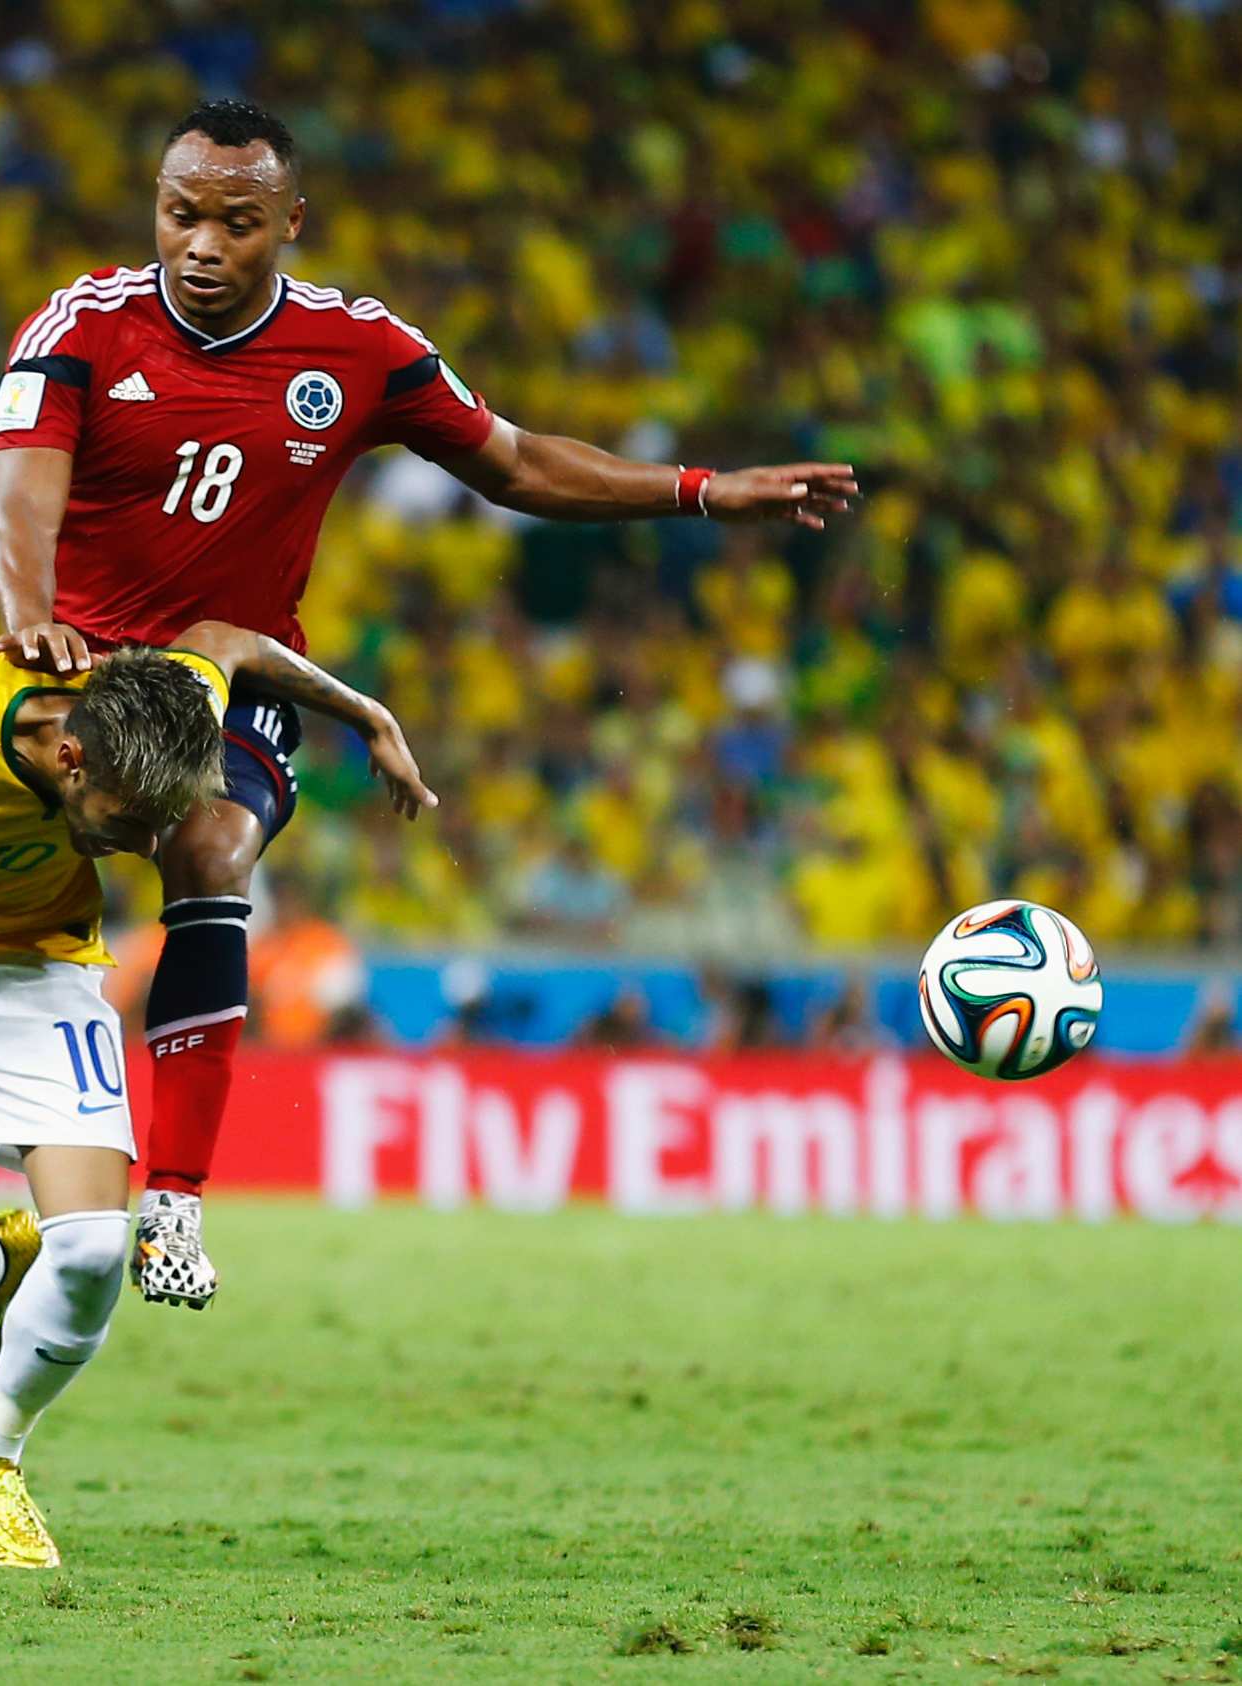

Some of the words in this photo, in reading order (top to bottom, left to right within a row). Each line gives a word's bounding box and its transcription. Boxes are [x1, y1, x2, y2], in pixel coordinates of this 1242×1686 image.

[108, 387, 155, 401] adidas
[161, 440, 243, 523] 18
[53, 1020, 122, 1097] 10
[156, 1034, 205, 1058] FCF
[320, 1056, 582, 1215] Fly
